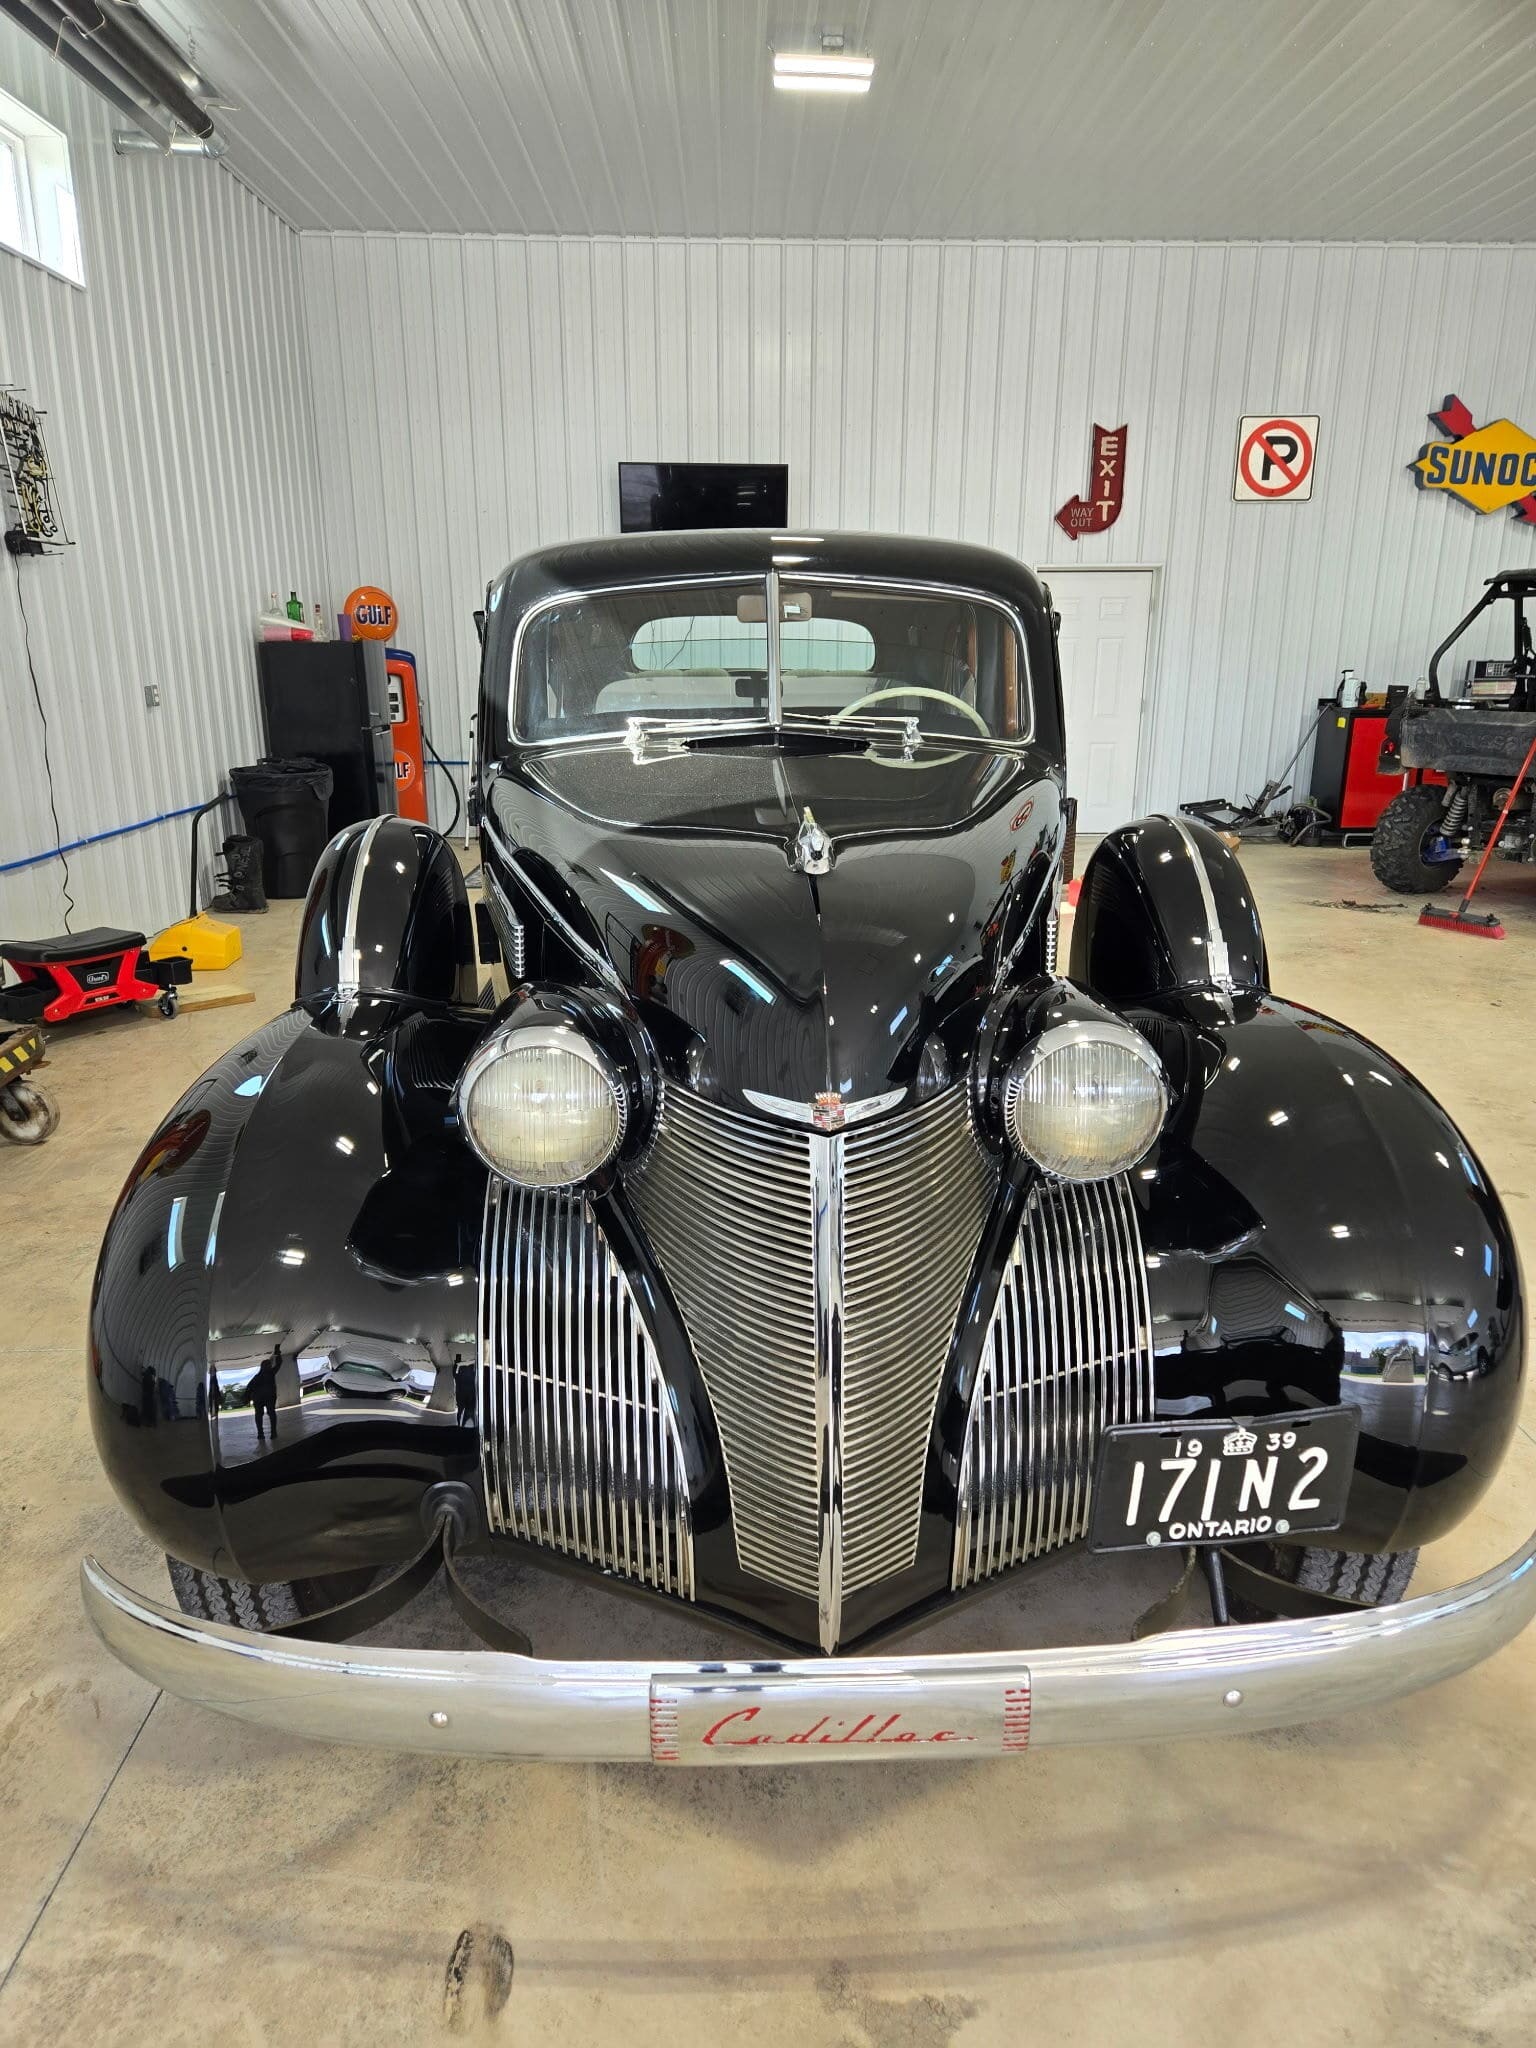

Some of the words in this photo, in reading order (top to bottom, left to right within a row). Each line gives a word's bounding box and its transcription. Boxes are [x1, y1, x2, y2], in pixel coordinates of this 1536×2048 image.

[1261, 436, 1299, 481] P
[1095, 436, 1119, 522] EXIT
[1070, 506, 1095, 518] WAY
[1070, 517, 1093, 528] OUT
[355, 604, 392, 626] GULF
[394, 761, 410, 779] LF
[1174, 1438, 1203, 1459] 19
[1265, 1431, 1297, 1451] 39
[1168, 1515, 1272, 1540] ONTARIO
[701, 1706, 977, 1745] Cadillac
